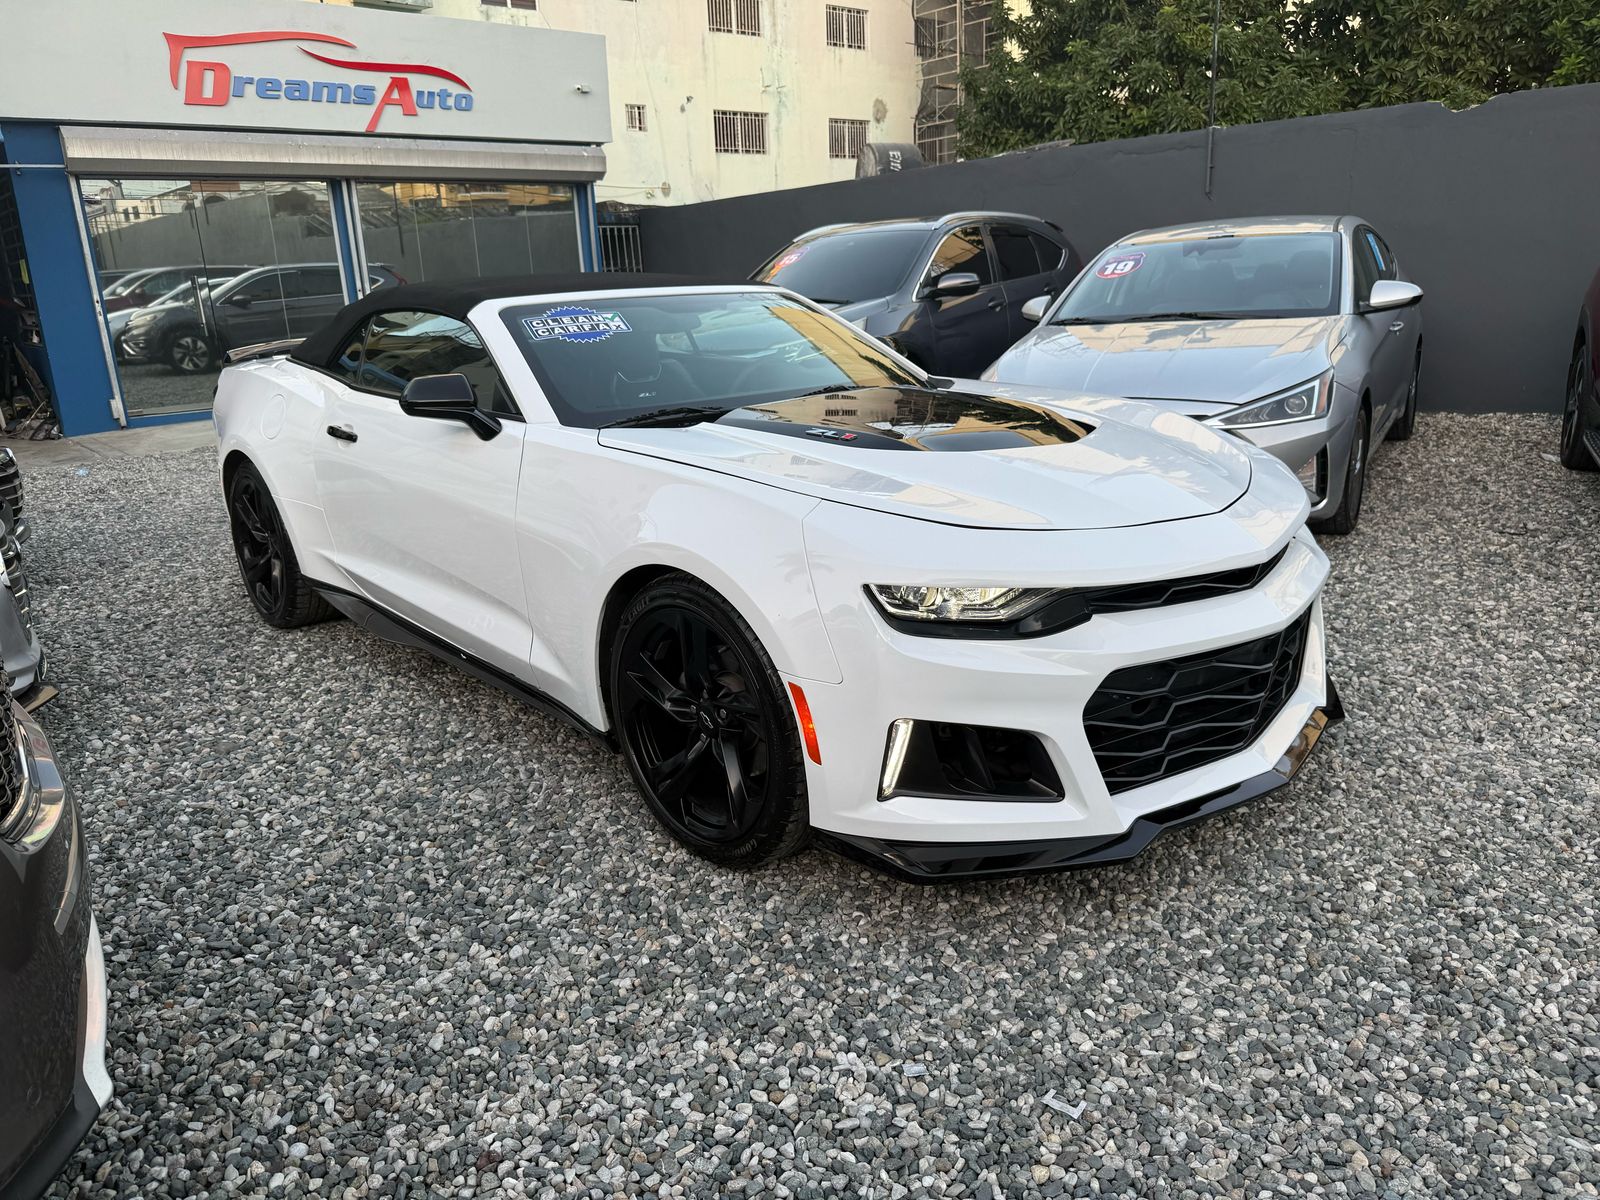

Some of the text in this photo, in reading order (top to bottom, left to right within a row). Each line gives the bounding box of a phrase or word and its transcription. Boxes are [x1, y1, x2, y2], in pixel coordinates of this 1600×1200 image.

[1104, 260, 1136, 275] 19
[531, 313, 602, 328] CLEAN
[537, 322, 623, 336] CARFAX
